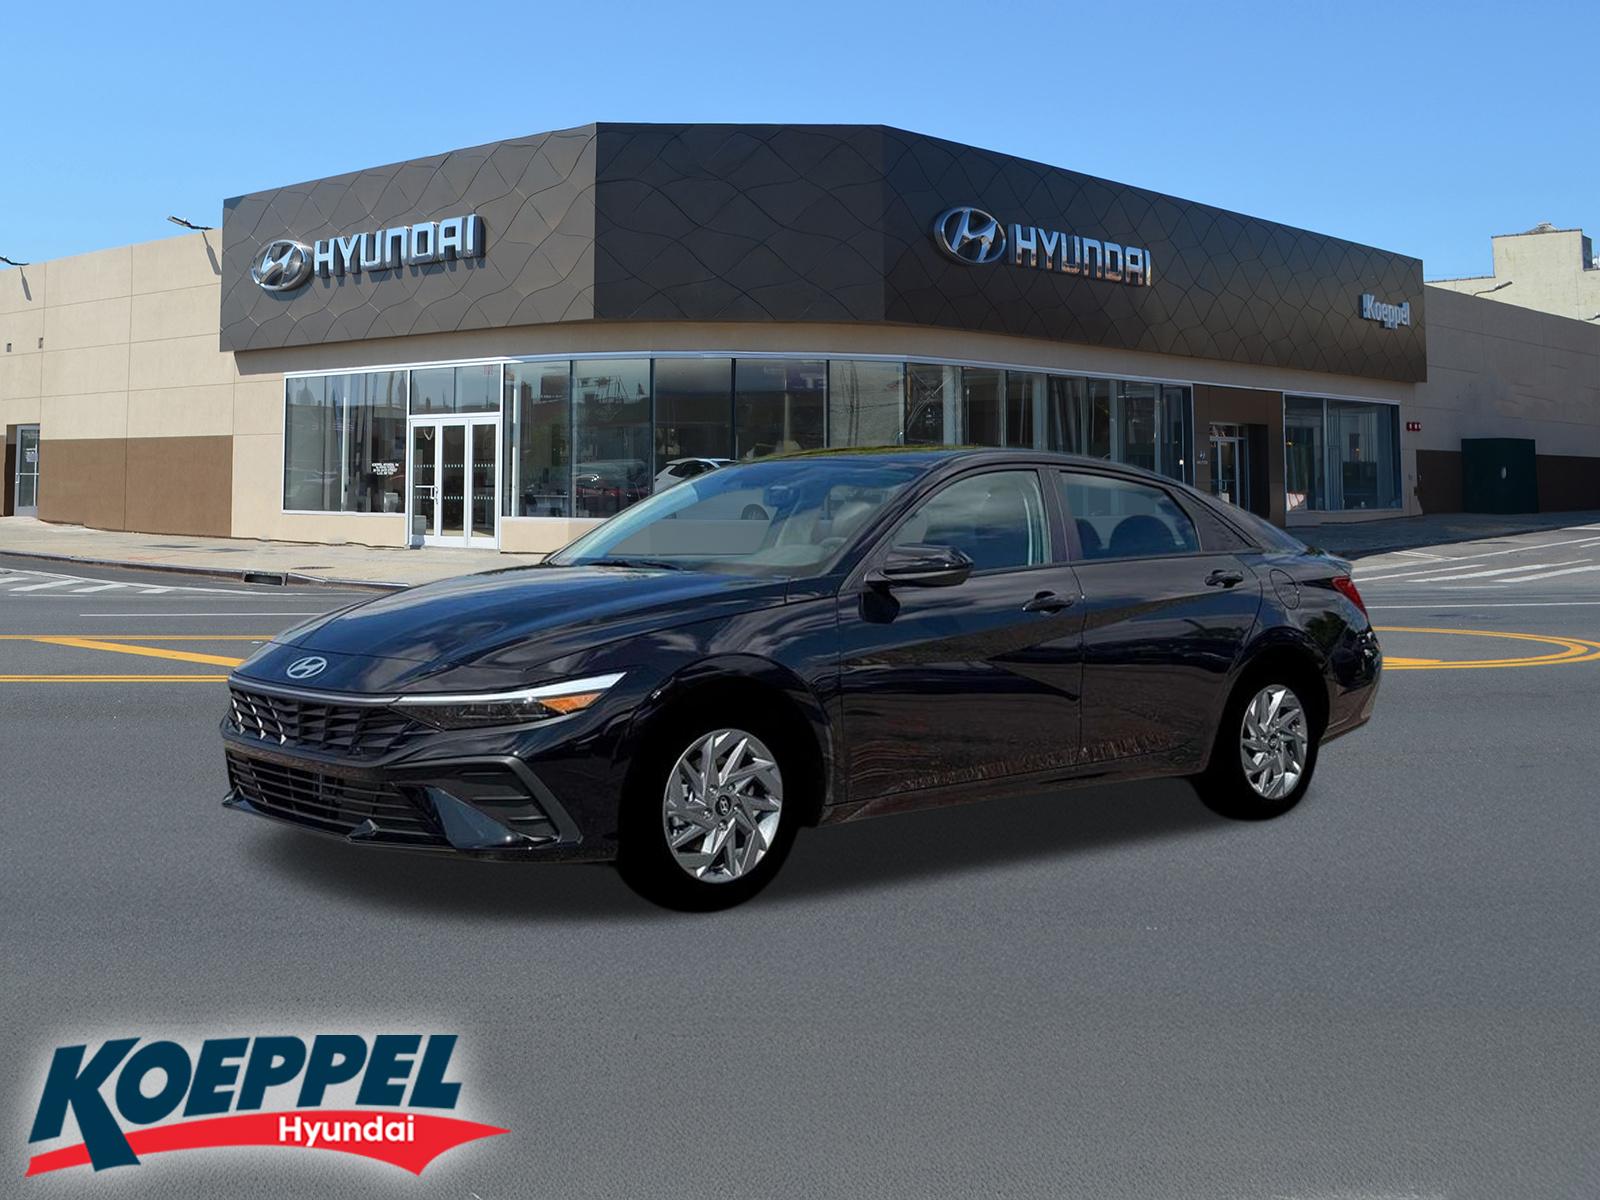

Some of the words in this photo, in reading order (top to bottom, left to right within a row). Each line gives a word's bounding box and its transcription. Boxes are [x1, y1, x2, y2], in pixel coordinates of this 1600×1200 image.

[314, 214, 484, 276] HYUNDAI
[1010, 223, 1152, 287] HYUNDAI
[1361, 293, 1411, 330] Koeppel
